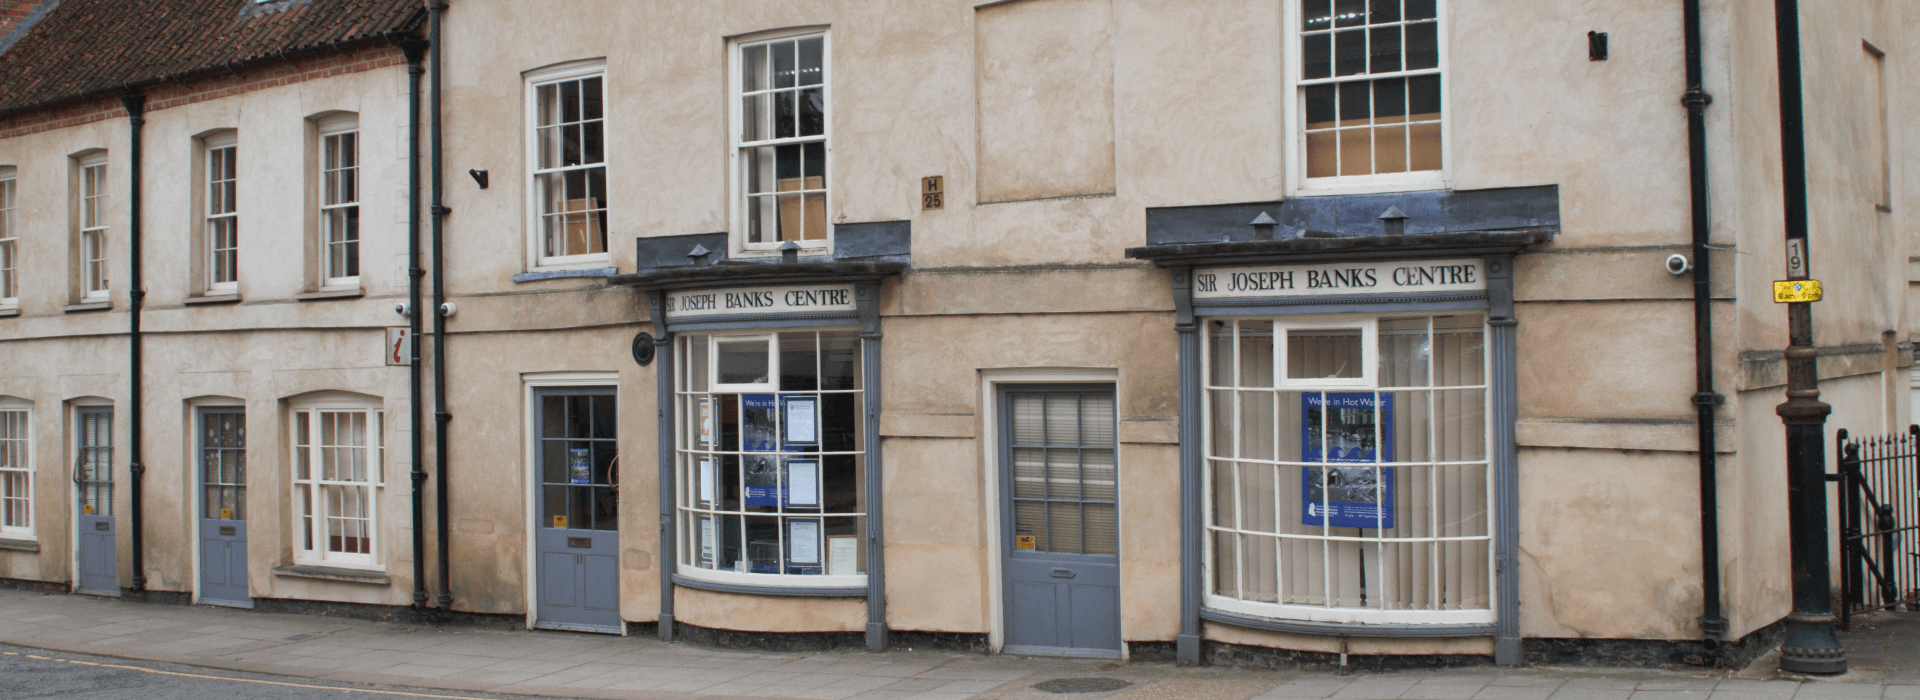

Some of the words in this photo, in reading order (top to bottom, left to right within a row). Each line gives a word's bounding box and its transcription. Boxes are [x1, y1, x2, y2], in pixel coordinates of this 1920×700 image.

[928, 179, 937, 191] H
[925, 195, 941, 208] 25
[1197, 273, 1217, 292] SIR
[1227, 271, 1294, 291] JOSEPH
[1307, 268, 1377, 289] BANKS
[1392, 264, 1476, 286] CENTRE
[667, 297, 676, 312] SIR
[680, 294, 716, 311] JOSEPH
[725, 291, 774, 309] BANKS
[785, 289, 850, 306] CENTRE
[1343, 398, 1358, 406] Hot
